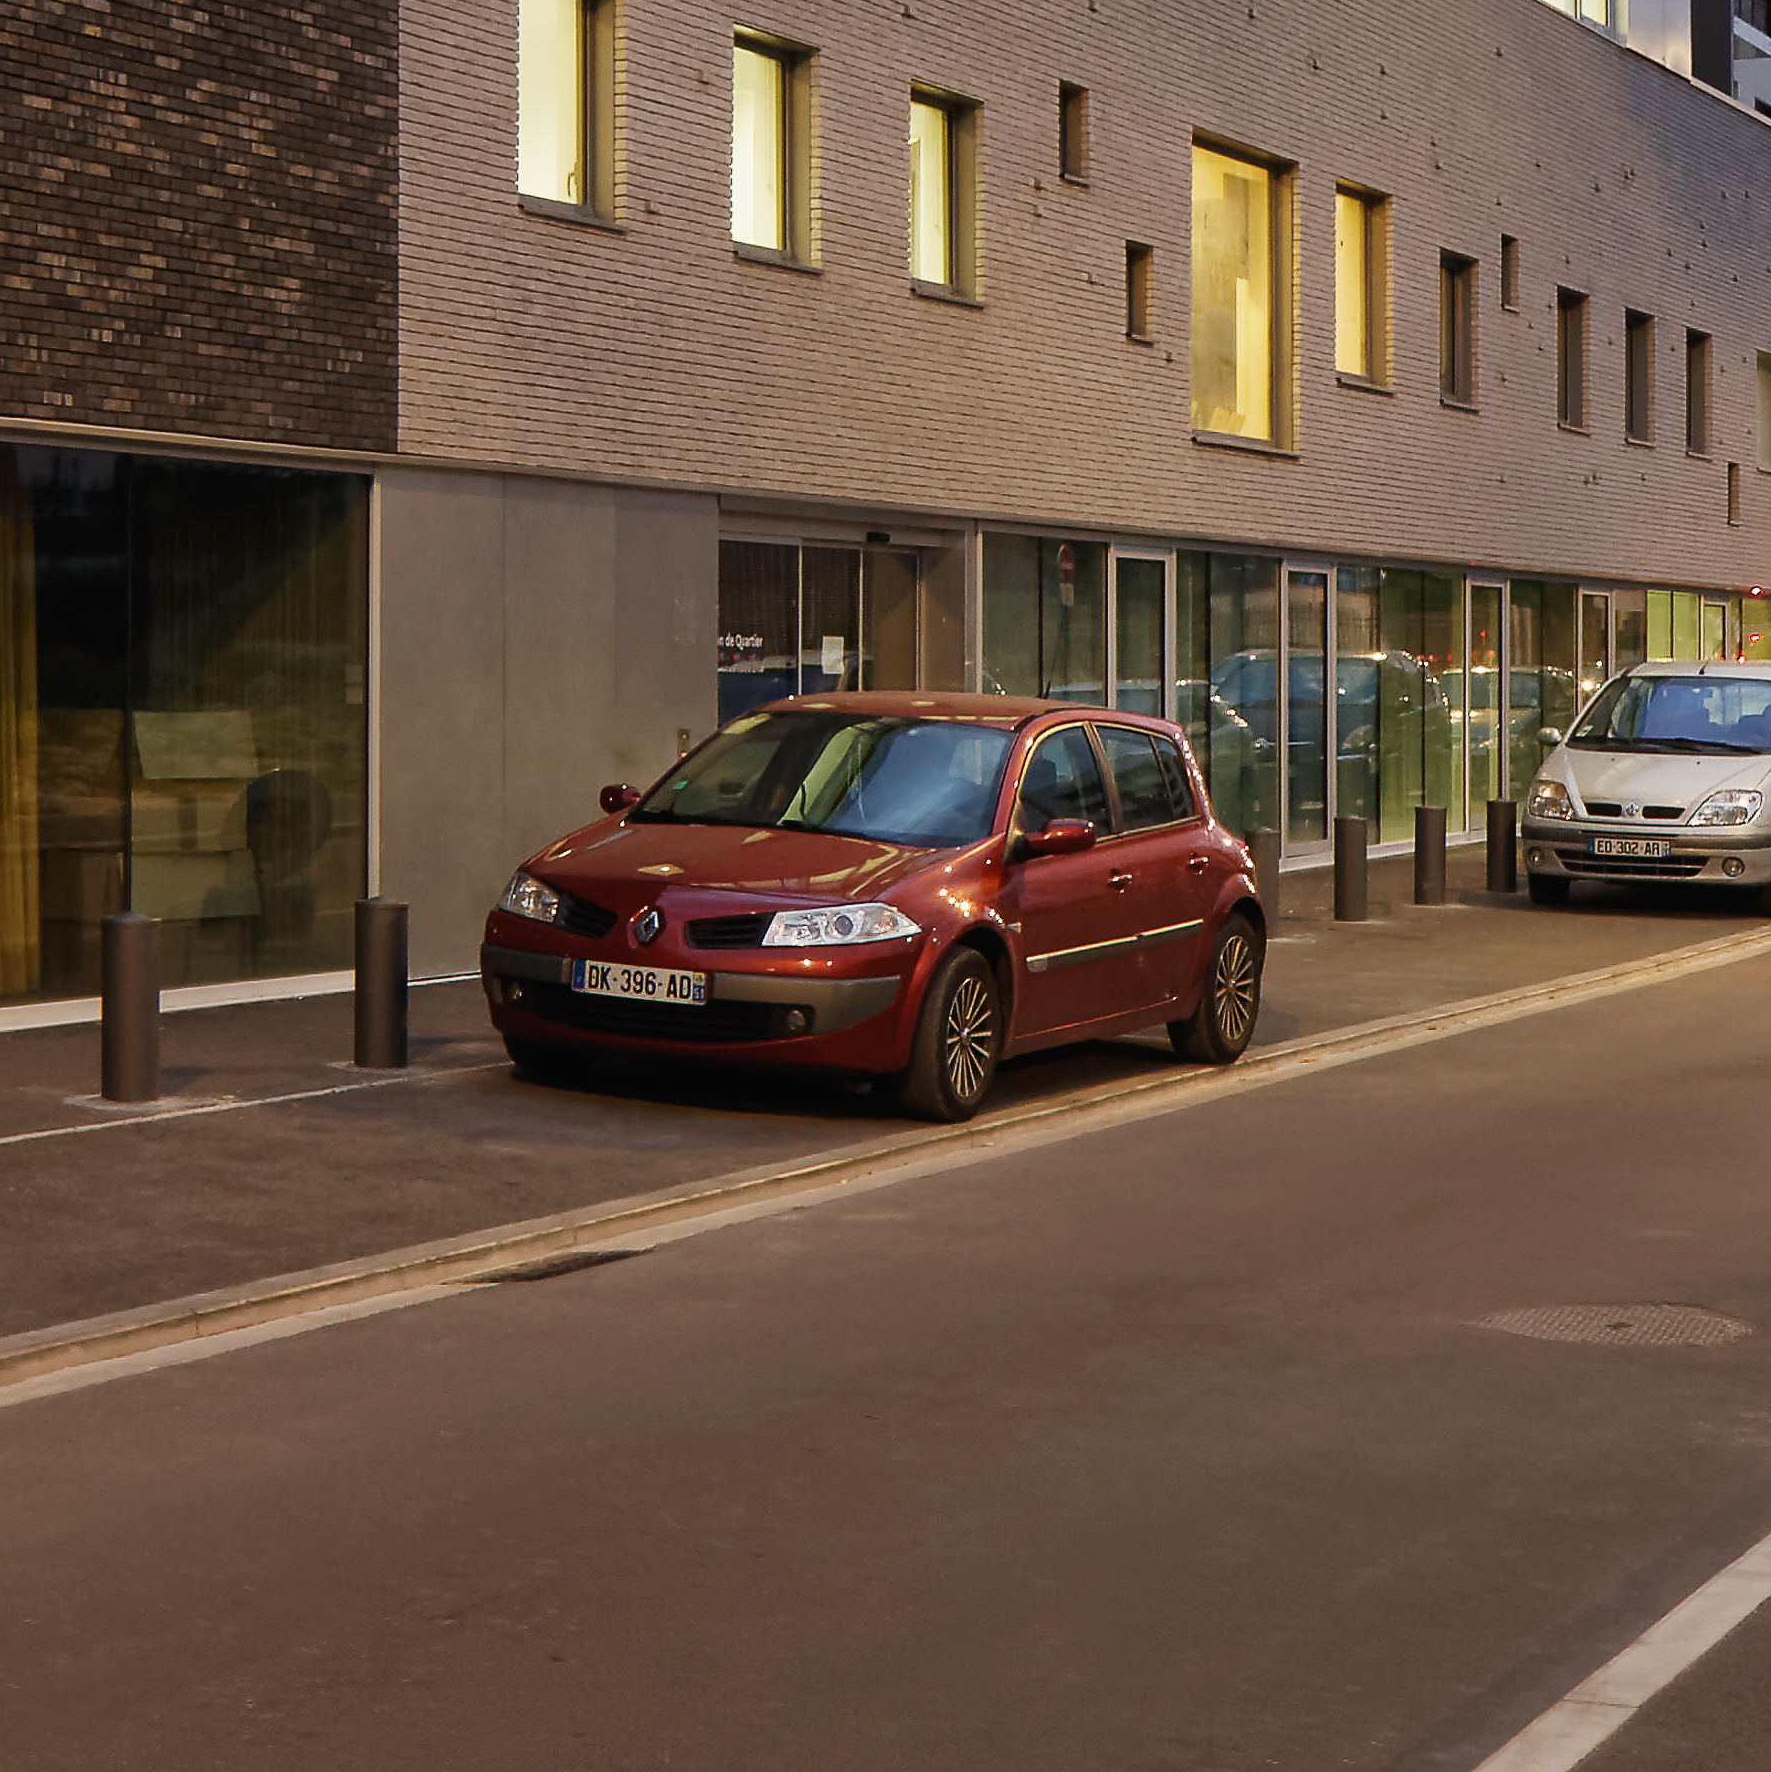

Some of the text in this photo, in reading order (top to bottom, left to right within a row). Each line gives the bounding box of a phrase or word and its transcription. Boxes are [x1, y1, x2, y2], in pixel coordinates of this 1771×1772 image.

[725, 632, 735, 647] de
[736, 633, 763, 650] Quartier
[587, 964, 691, 1000] DK-396-AD
